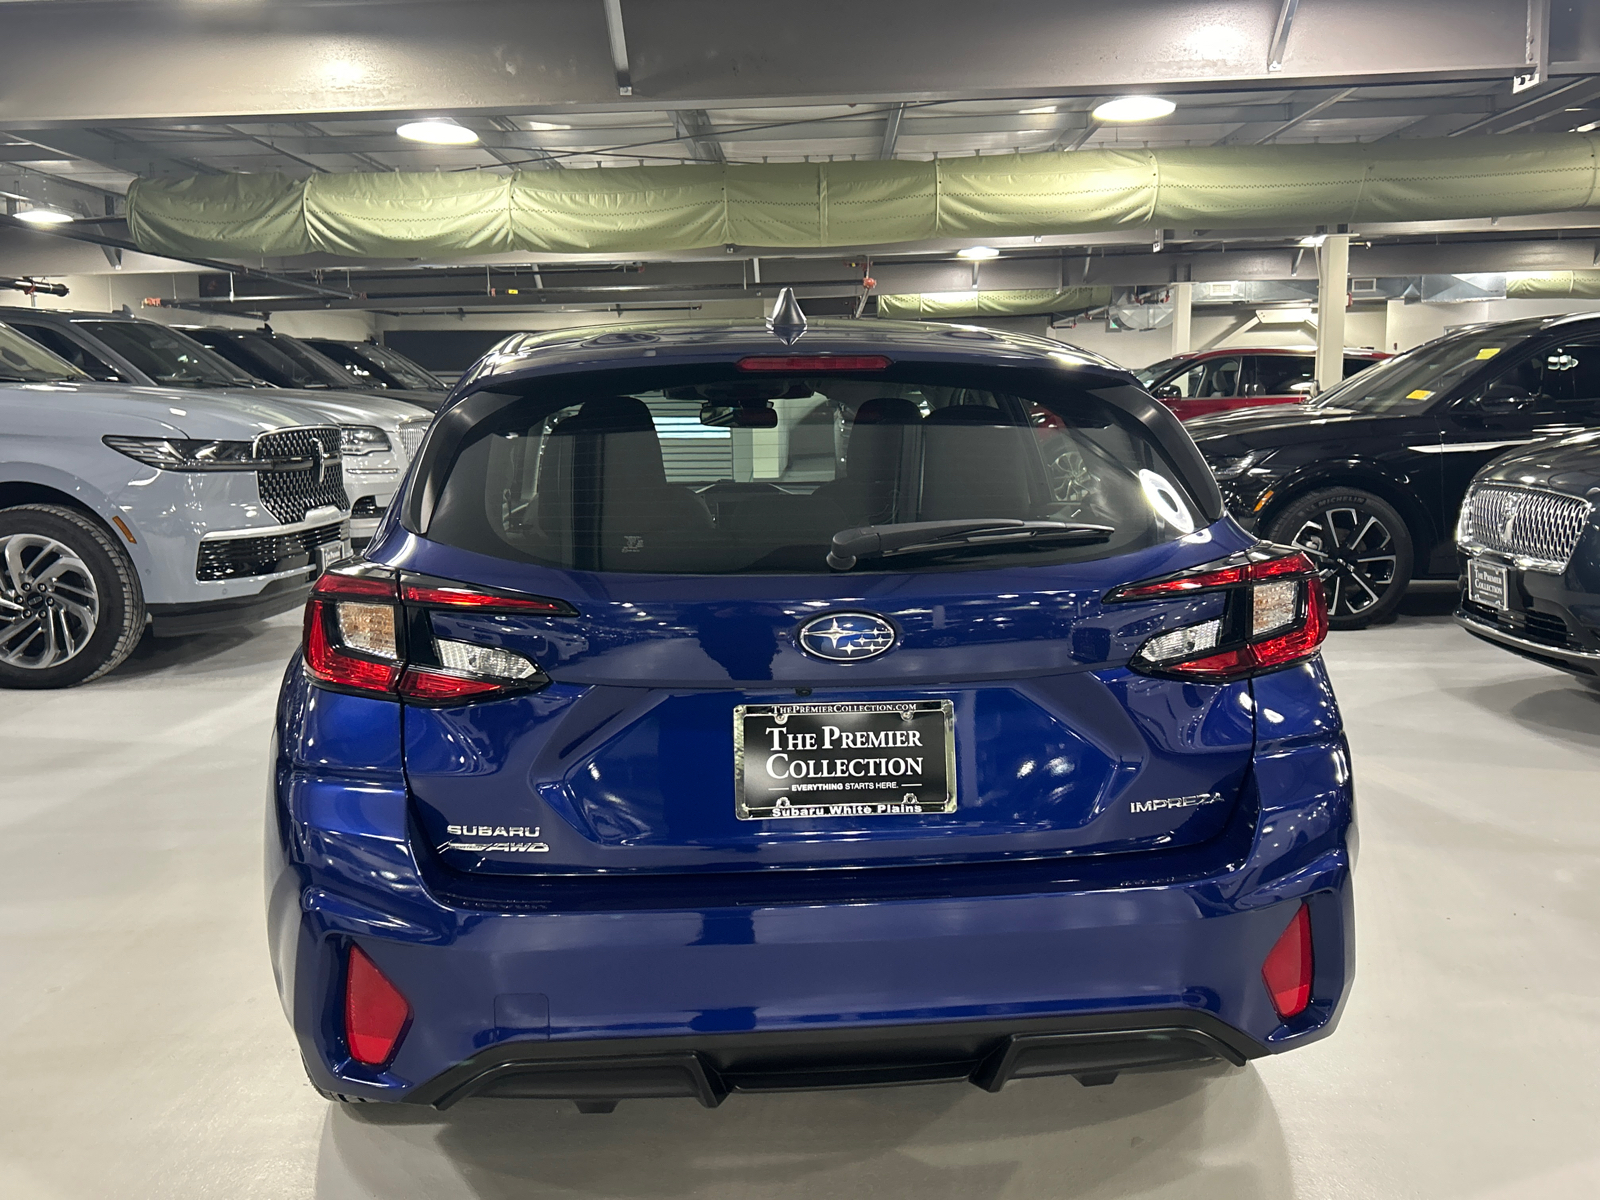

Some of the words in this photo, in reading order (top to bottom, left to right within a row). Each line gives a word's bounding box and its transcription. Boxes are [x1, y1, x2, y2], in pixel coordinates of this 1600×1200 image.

[1318, 496, 1365, 507] MICHELIN
[765, 726, 818, 751] THE
[821, 725, 923, 750] PREMIER
[765, 753, 924, 779] COLLECTION
[791, 783, 843, 792] EVERYTHING
[844, 782, 875, 790] STARTS
[875, 781, 899, 789] HERE.
[1130, 792, 1225, 813] IMPREZA
[772, 807, 824, 817] Subaru
[829, 804, 872, 815] White
[877, 803, 923, 814] Plains
[447, 824, 540, 837] SUBARU
[486, 842, 550, 852] AWD
